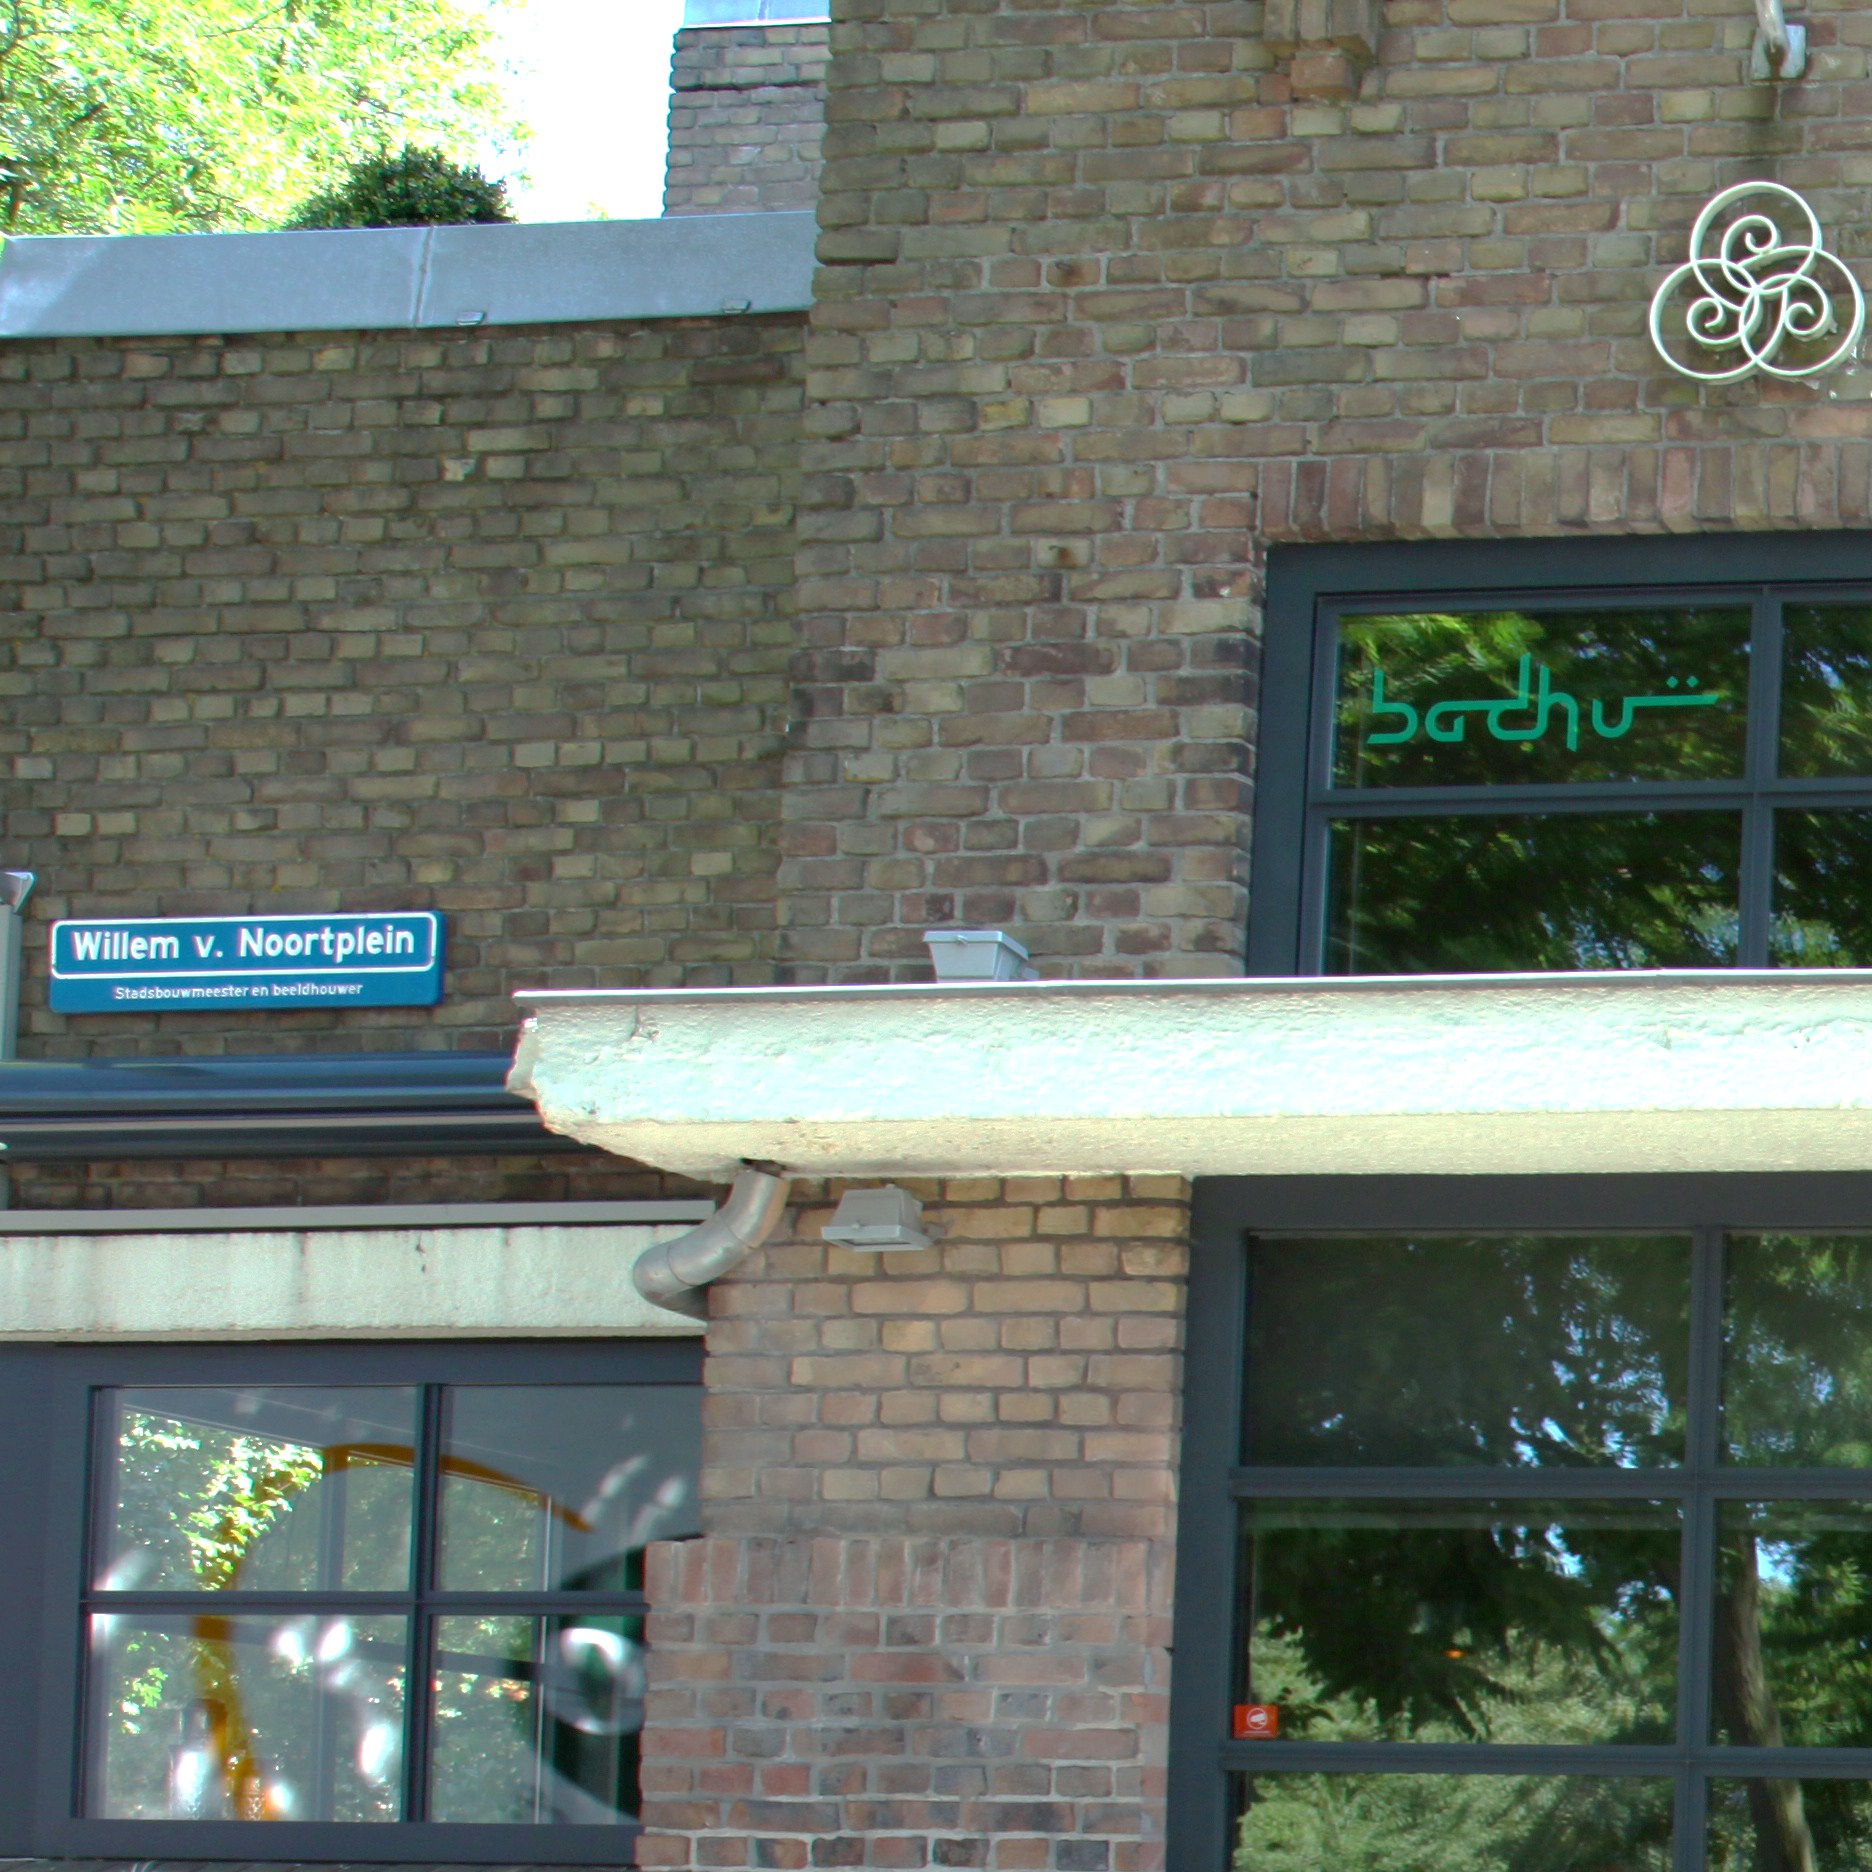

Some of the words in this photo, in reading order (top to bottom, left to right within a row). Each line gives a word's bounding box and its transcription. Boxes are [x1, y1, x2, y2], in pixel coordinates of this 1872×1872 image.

[73, 930, 180, 961] Willem
[194, 935, 224, 959] v.
[239, 925, 415, 963] Noortplein
[114, 984, 250, 1000] Stadsbouwmeester
[251, 986, 269, 998] en
[272, 982, 364, 997] beeldhouwer
